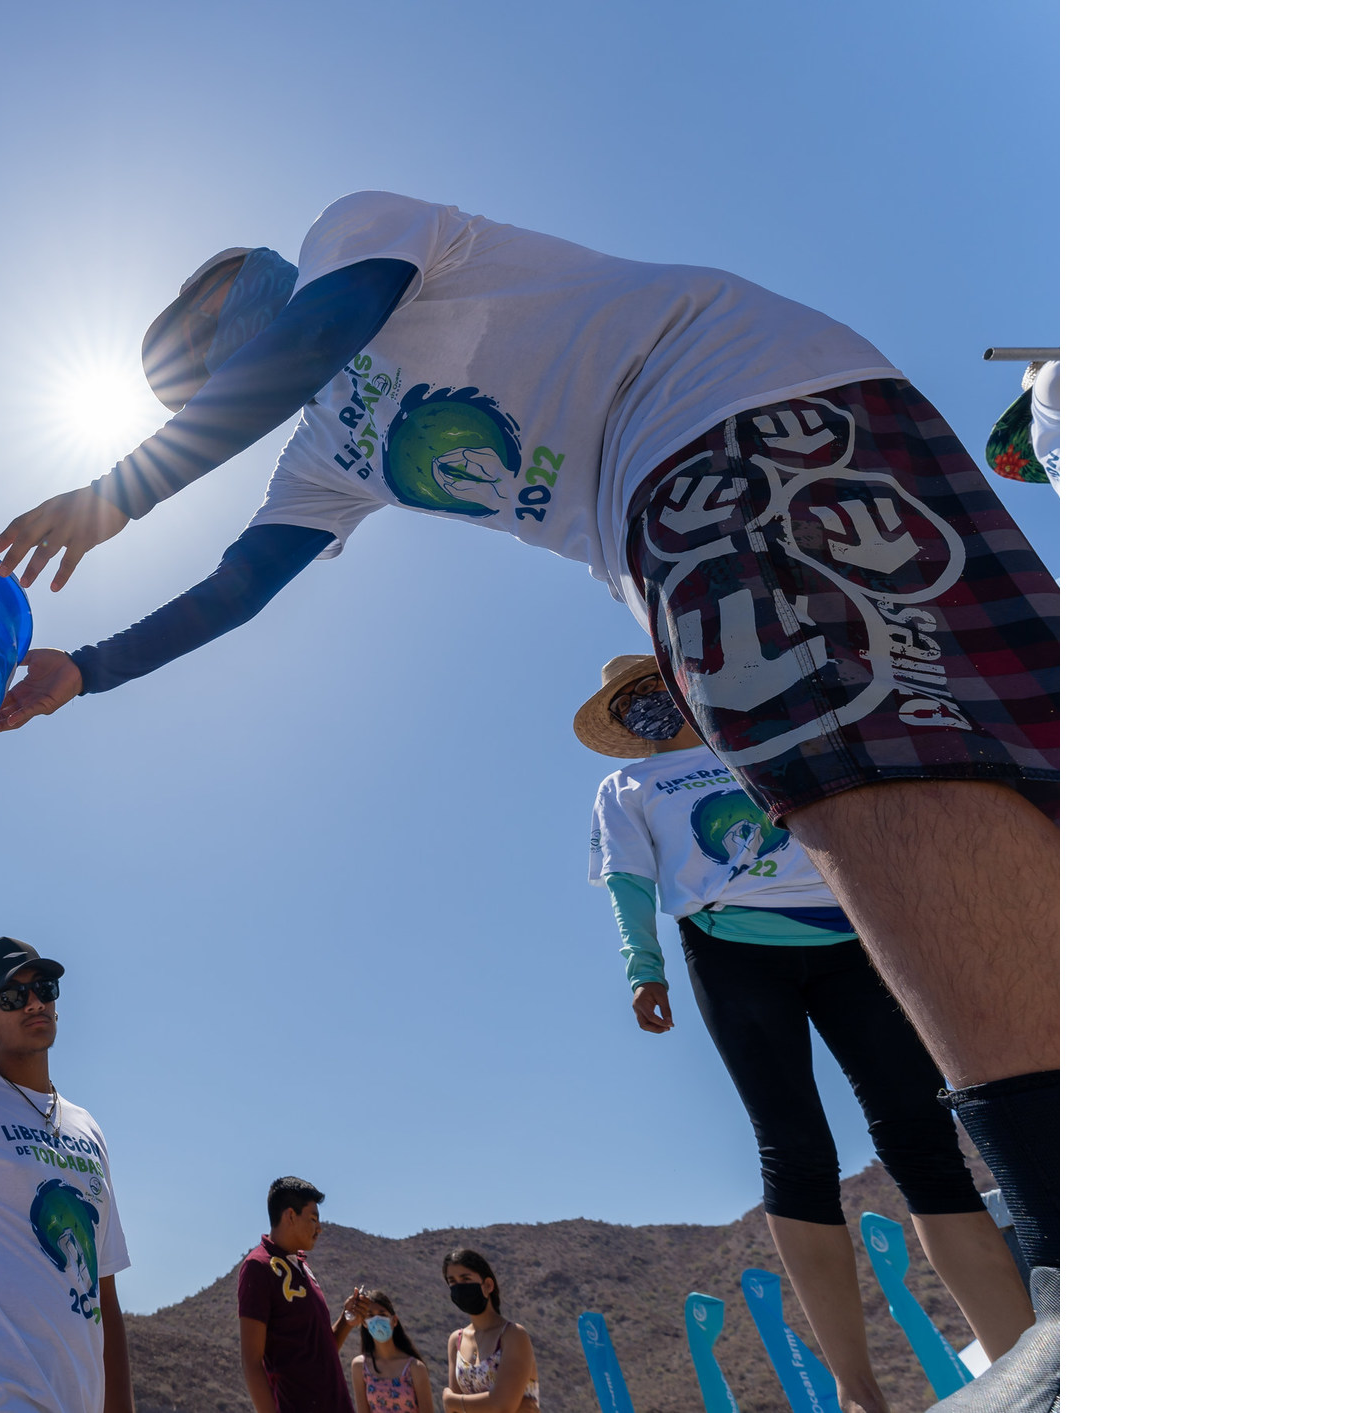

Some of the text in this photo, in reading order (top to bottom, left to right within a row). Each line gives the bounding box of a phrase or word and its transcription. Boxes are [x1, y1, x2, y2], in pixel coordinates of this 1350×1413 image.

[515, 446, 565, 522] 2022
[16, 1145, 105, 1178] DE TOTOABAS
[270, 1256, 306, 1302] 2
[784, 1327, 824, 1413] Ocean Farms
